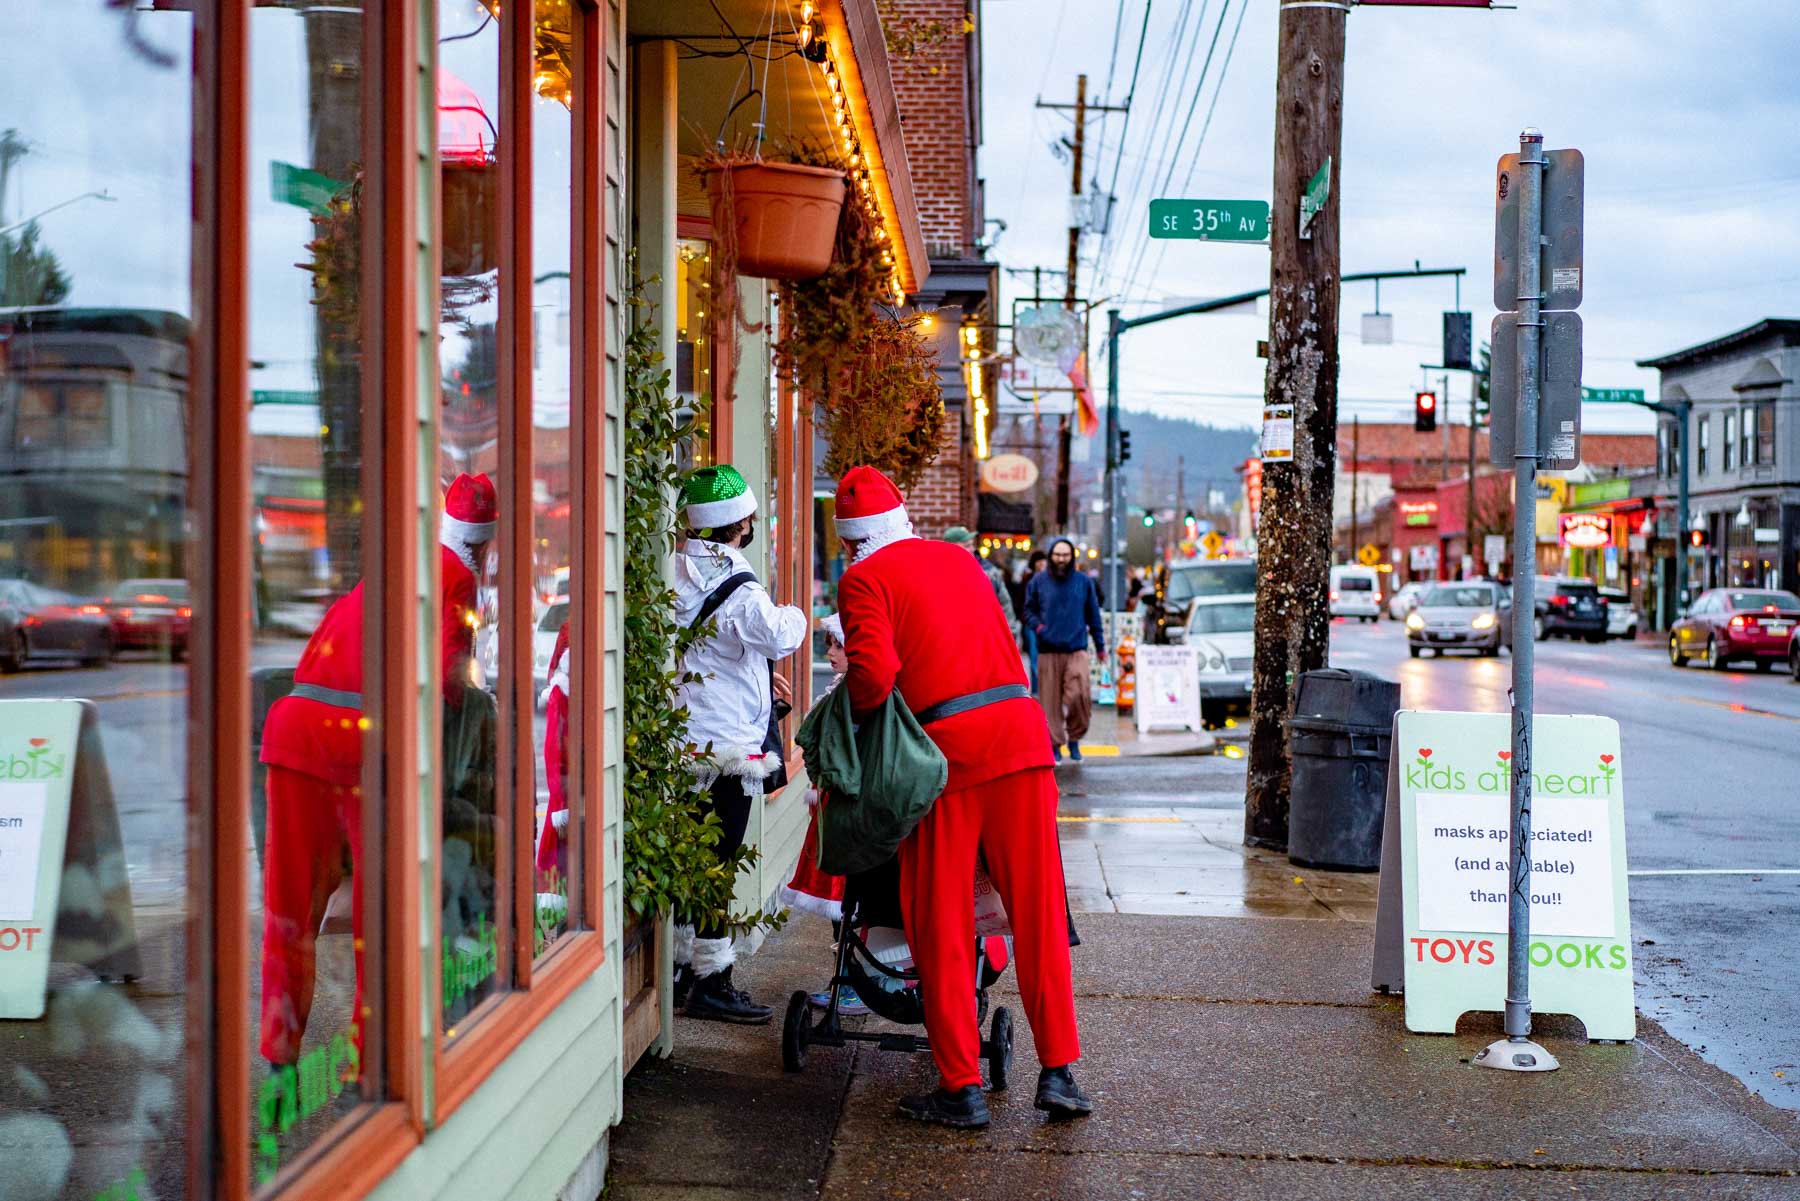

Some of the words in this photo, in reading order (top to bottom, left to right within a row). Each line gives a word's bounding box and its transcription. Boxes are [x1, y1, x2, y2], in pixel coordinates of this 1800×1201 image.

[1163, 216, 1178, 231] SE
[1192, 208, 1231, 231] 35th
[1406, 757, 1466, 791] kids
[1434, 825, 1485, 839] masks
[1489, 828, 1592, 843] apeciated!
[1454, 856, 1490, 871] (and
[1495, 859, 1575, 874] avlable)
[1470, 889, 1507, 903] than
[1531, 892, 1562, 905] ou!!
[1410, 937, 1495, 966] TOYS
[1529, 942, 1627, 970] OOKS
